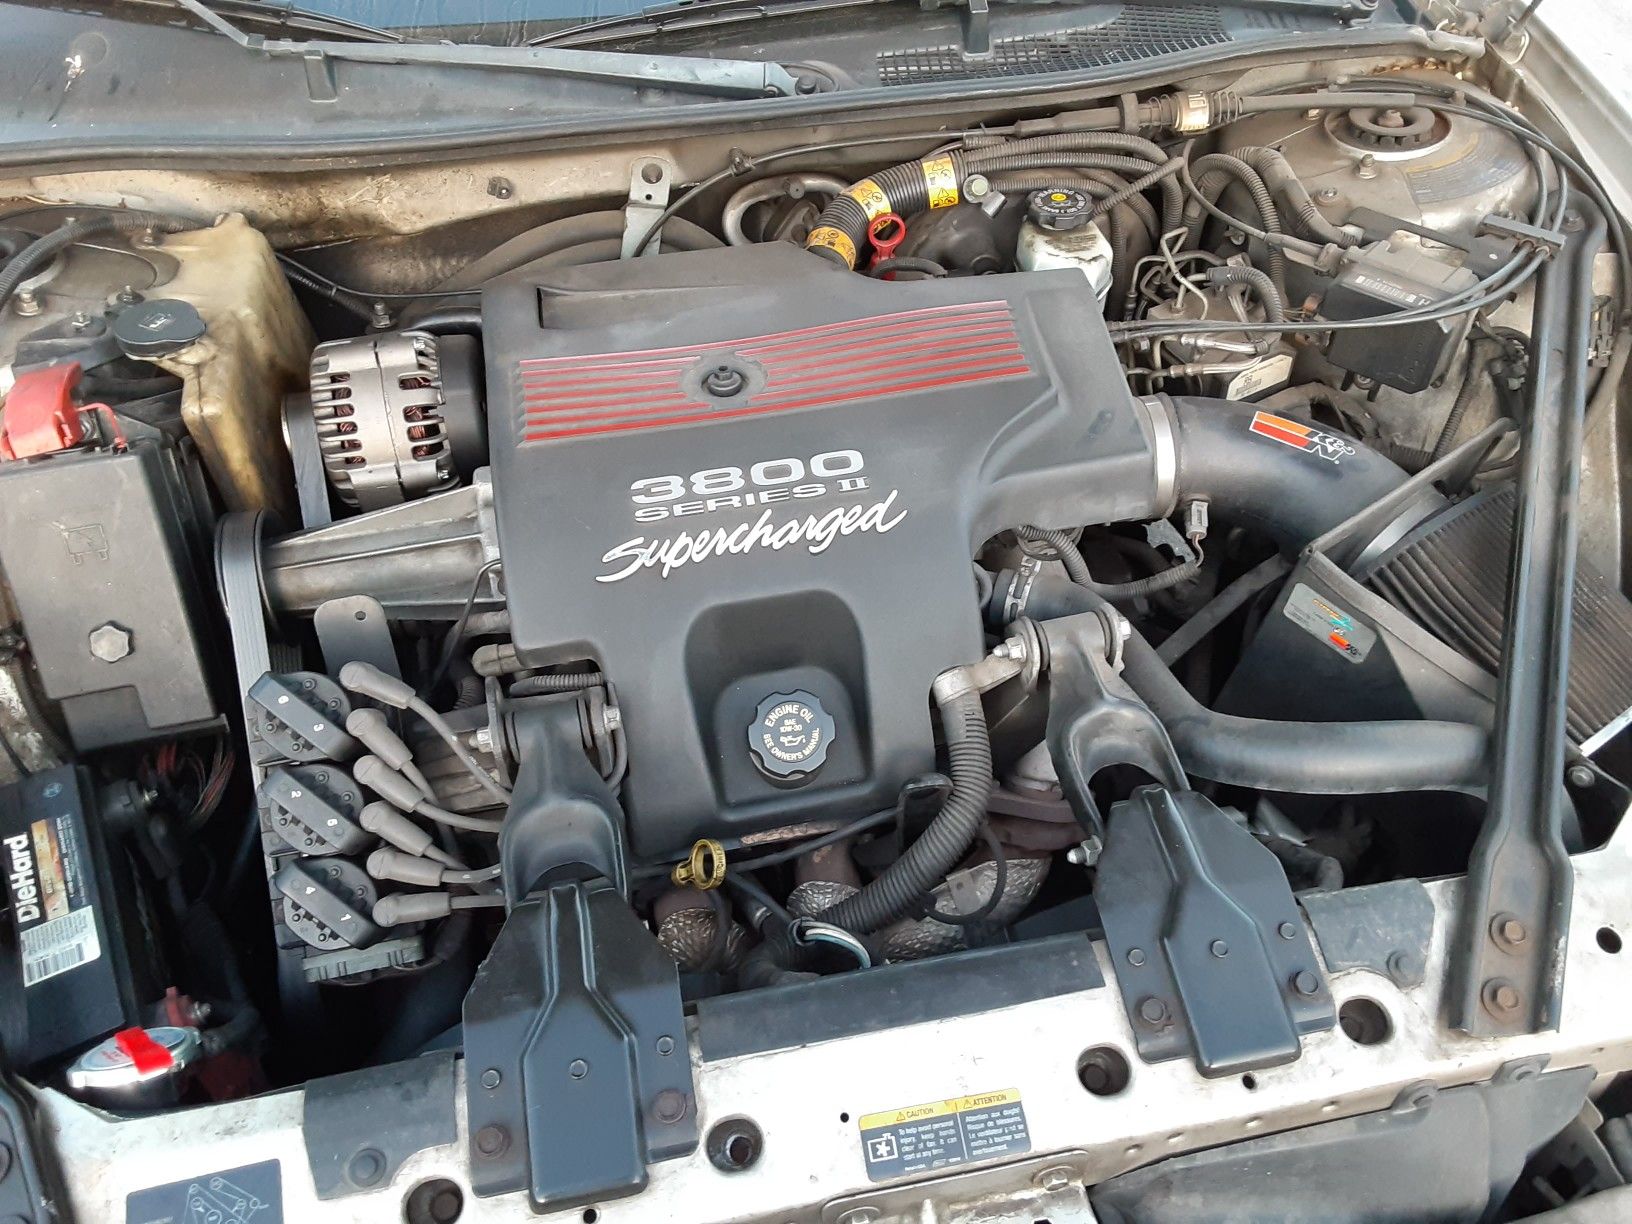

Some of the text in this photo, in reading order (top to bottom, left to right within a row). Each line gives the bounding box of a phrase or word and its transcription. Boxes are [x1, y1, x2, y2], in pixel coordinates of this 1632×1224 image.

[630, 449, 864, 505] 3800
[634, 476, 870, 522] SERIES II
[595, 489, 908, 583] Supercharged
[764, 704, 814, 728] ENGINE OIL
[802, 727, 820, 756] MANUAL
[3, 832, 41, 924] DieHard
[906, 1107, 934, 1118] CAUTION
[973, 1093, 1007, 1106] ATTENTION
